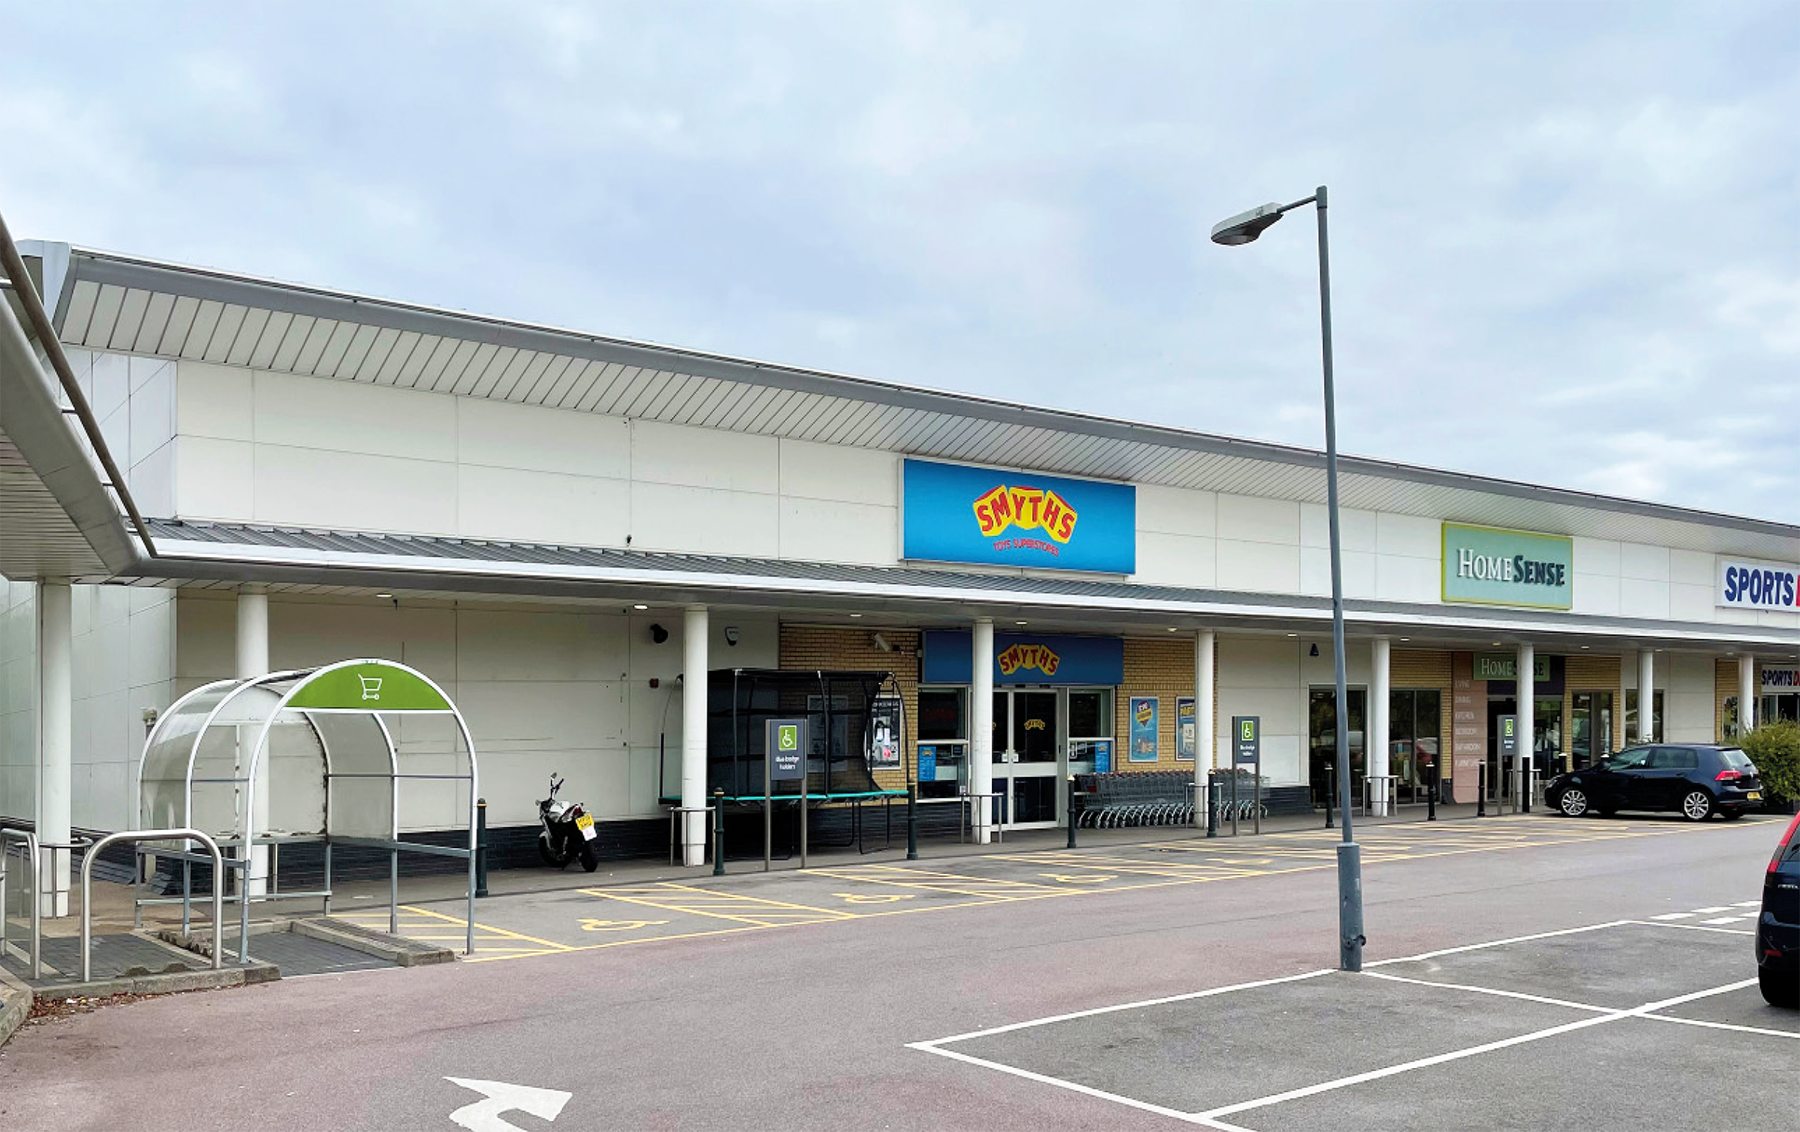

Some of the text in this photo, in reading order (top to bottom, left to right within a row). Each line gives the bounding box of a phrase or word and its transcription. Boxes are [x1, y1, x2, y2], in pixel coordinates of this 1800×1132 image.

[976, 491, 1075, 540] SMYTHS
[993, 539, 1011, 551] TOYS
[1724, 566, 1794, 606] SPORTS
[999, 647, 1058, 673] SMYTHS
[1761, 669, 1793, 687] SPORTS
